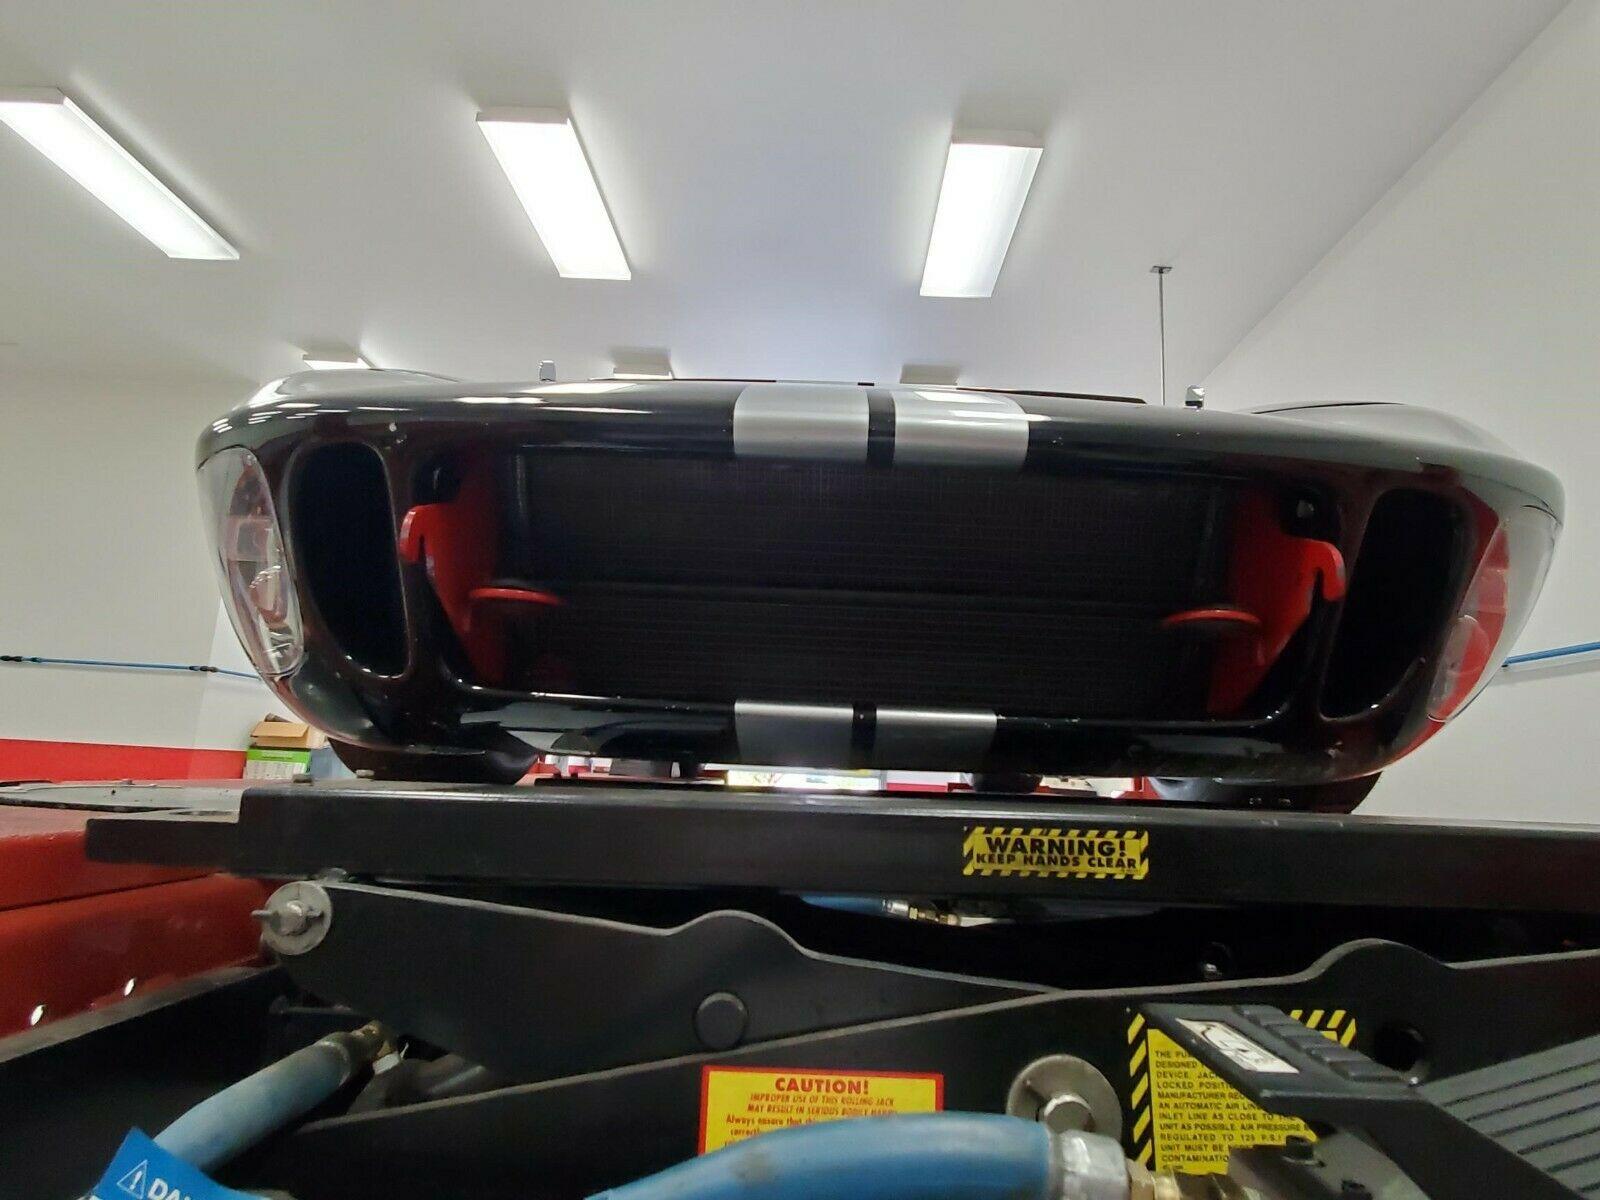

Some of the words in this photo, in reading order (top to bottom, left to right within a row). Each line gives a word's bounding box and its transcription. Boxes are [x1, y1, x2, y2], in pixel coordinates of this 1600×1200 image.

[985, 836, 1126, 857] WARNING!
[976, 853, 1018, 865] KEEP
[1024, 855, 1081, 867] HANDS
[1088, 856, 1136, 869] CLEAR
[1155, 1050, 1171, 1058] THE
[1156, 1061, 1198, 1069] DESIGNED
[775, 1077, 869, 1095] CAUTION!
[1157, 1091, 1227, 1099] MANUFACTURER
[751, 1092, 790, 1103] IMPROPER
[793, 1094, 806, 1104] USE
[810, 1095, 819, 1103] OF
[822, 1095, 838, 1104] THIS
[841, 1096, 874, 1106] ROLLING
[876, 1097, 894, 1107] JACK
[747, 1103, 763, 1113] MAY
[767, 1104, 793, 1114] RESULT
[796, 1105, 804, 1115] IN
[1159, 1102, 1171, 1110] AN
[1173, 1102, 1222, 1110] AUTOMATIC
[1225, 1102, 1240, 1110] AIR
[726, 1114, 755, 1127] Always
[758, 1117, 784, 1126] ensure
[1159, 1112, 1183, 1120] INLET
[1187, 1112, 1208, 1120] LINE
[1212, 1112, 1224, 1120] AS
[1227, 1112, 1257, 1121] CLOSE
[1240, 1123, 1255, 1131] AIR
[1160, 1133, 1216, 1141] REGULATED
[1222, 1133, 1234, 1141] TO
[1161, 1144, 1180, 1152] UNIT
[1184, 1144, 1209, 1152] MUST
[1212, 1144, 1224, 1152] BE
